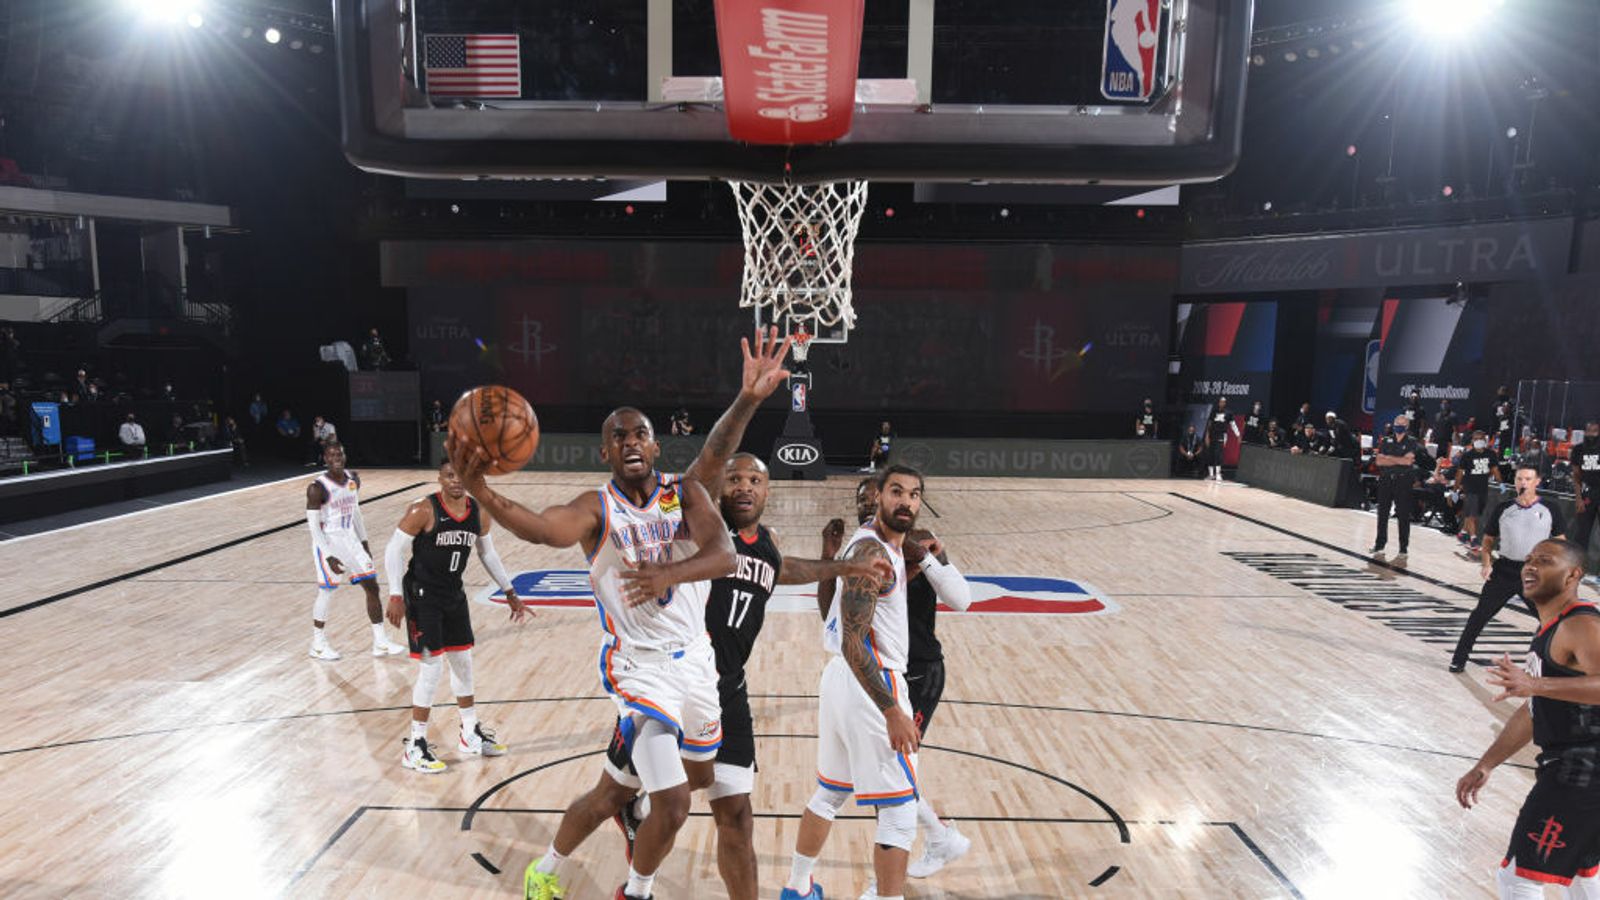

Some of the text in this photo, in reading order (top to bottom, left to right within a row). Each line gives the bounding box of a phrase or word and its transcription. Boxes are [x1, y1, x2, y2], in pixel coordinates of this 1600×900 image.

[1109, 72, 1134, 92] NBA
[1196, 232, 1537, 287] Michelob ULTRA
[416, 324, 471, 339] ULTRA
[1104, 331, 1161, 347] ULTRA
[1222, 381, 1249, 395] Season
[552, 445, 584, 465] UP
[784, 448, 812, 461] KIA
[946, 450, 1007, 470] SIGN
[1013, 450, 1045, 470] UP
[1050, 450, 1112, 471] NOW
[449, 551, 461, 572] 0
[726, 554, 775, 593] USTON
[727, 589, 753, 629] 17
